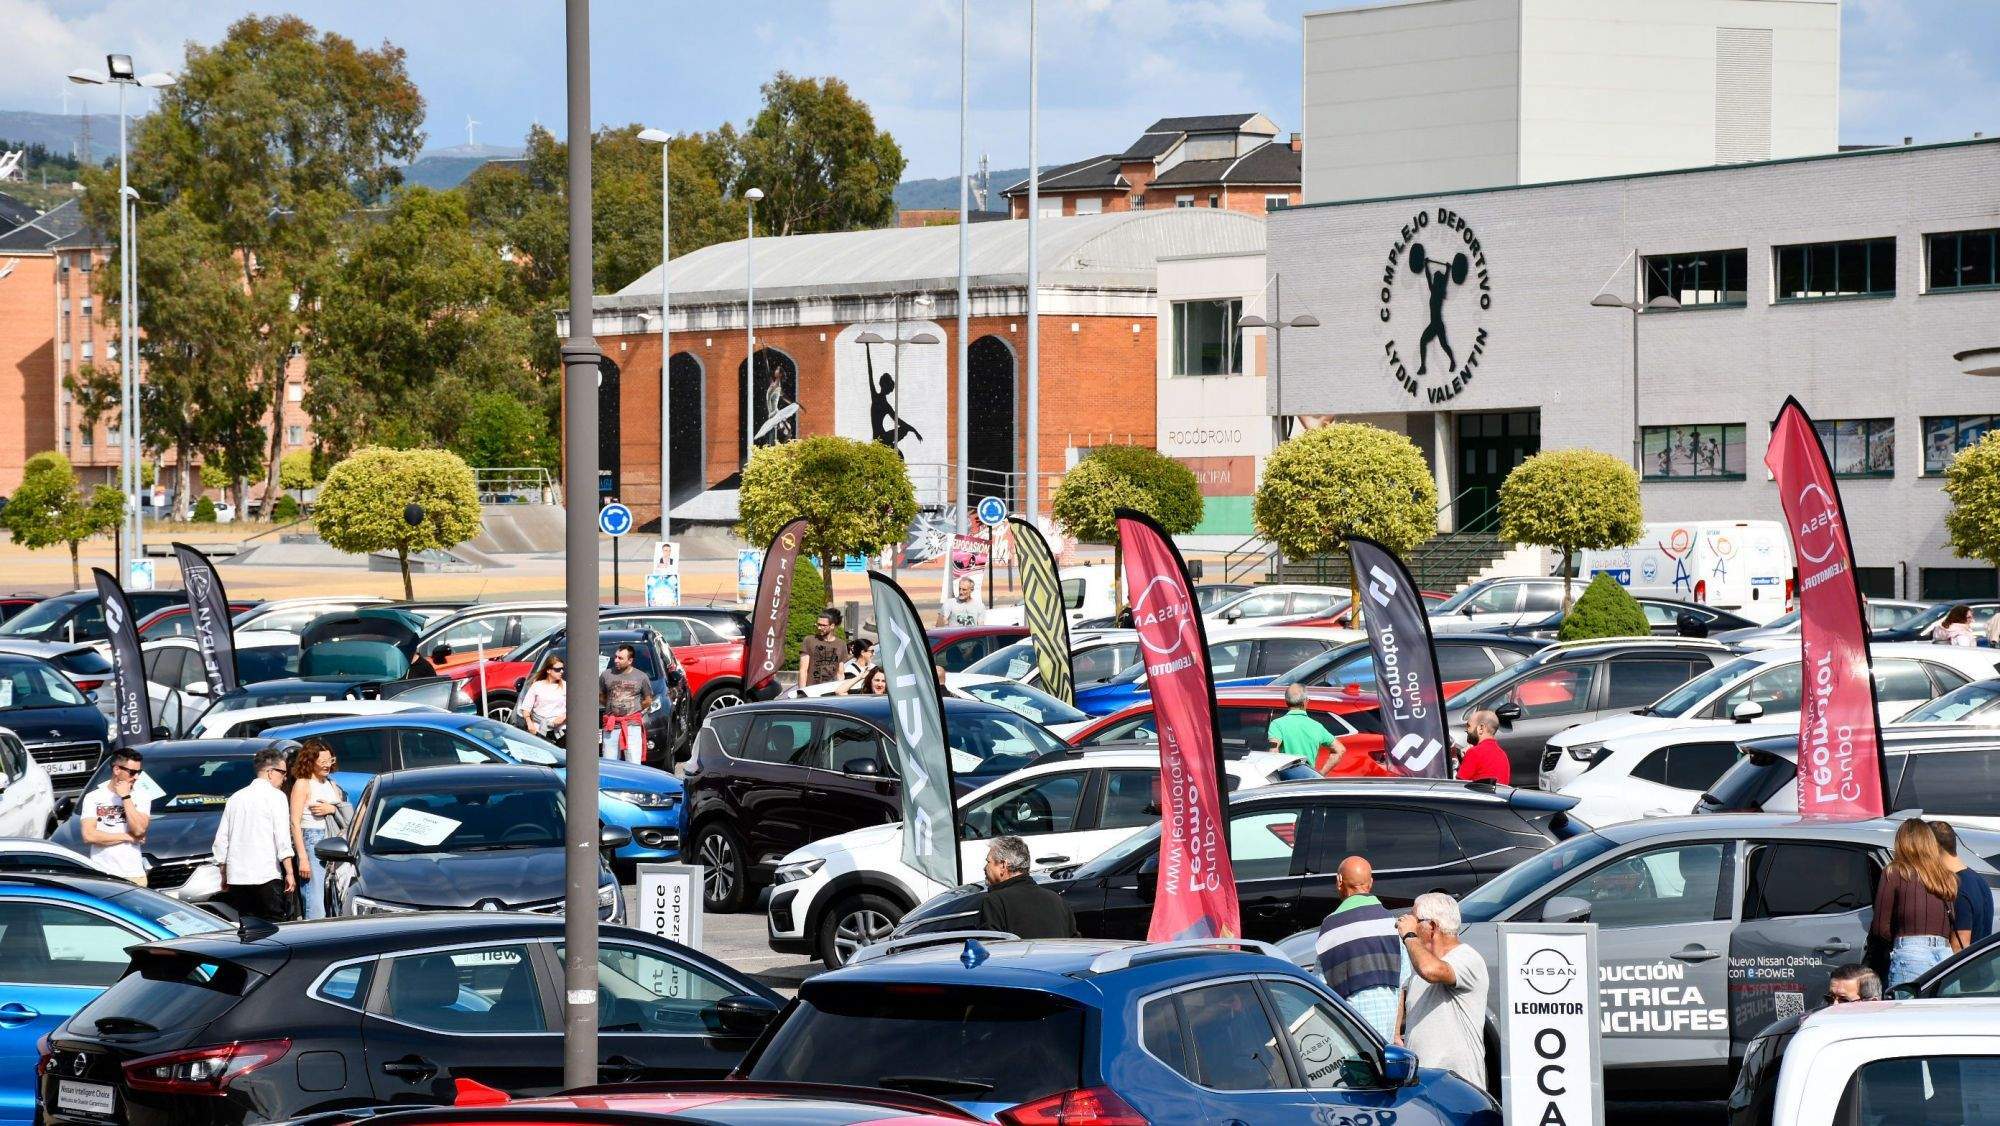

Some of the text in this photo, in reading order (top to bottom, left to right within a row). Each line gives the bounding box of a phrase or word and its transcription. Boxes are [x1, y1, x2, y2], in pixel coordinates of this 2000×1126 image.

[1380, 207, 1490, 322] COMPLEJO DEPORTIVO
[1384, 327, 1488, 404] LYDIA VALENTIN
[770, 575, 784, 620] CRUZ
[763, 626, 775, 671] AUTO
[1520, 968, 1577, 976] NISSAN
[1729, 956, 1823, 969] Nuevo Nissan Qashqai
[1729, 968, 1795, 978] con e-POWER
[1514, 1002, 1584, 1015] LEOMOTOR
